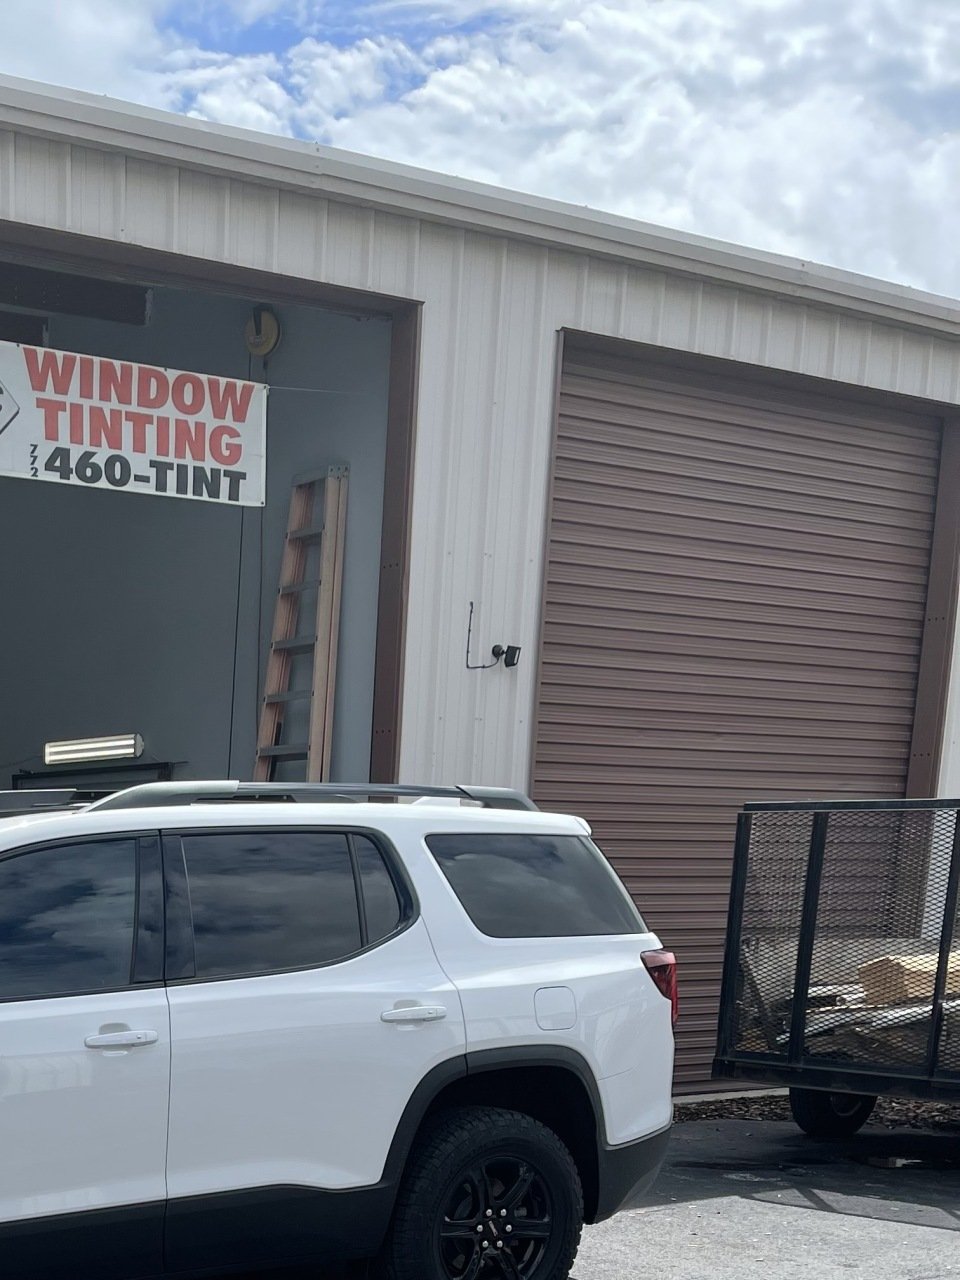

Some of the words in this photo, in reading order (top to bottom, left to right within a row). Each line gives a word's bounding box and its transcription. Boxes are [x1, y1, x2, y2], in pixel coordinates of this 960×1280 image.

[23, 347, 254, 423] WINDOW
[36, 397, 242, 466] TINTING
[29, 443, 39, 478] 772
[44, 447, 246, 502] 460-TINT
